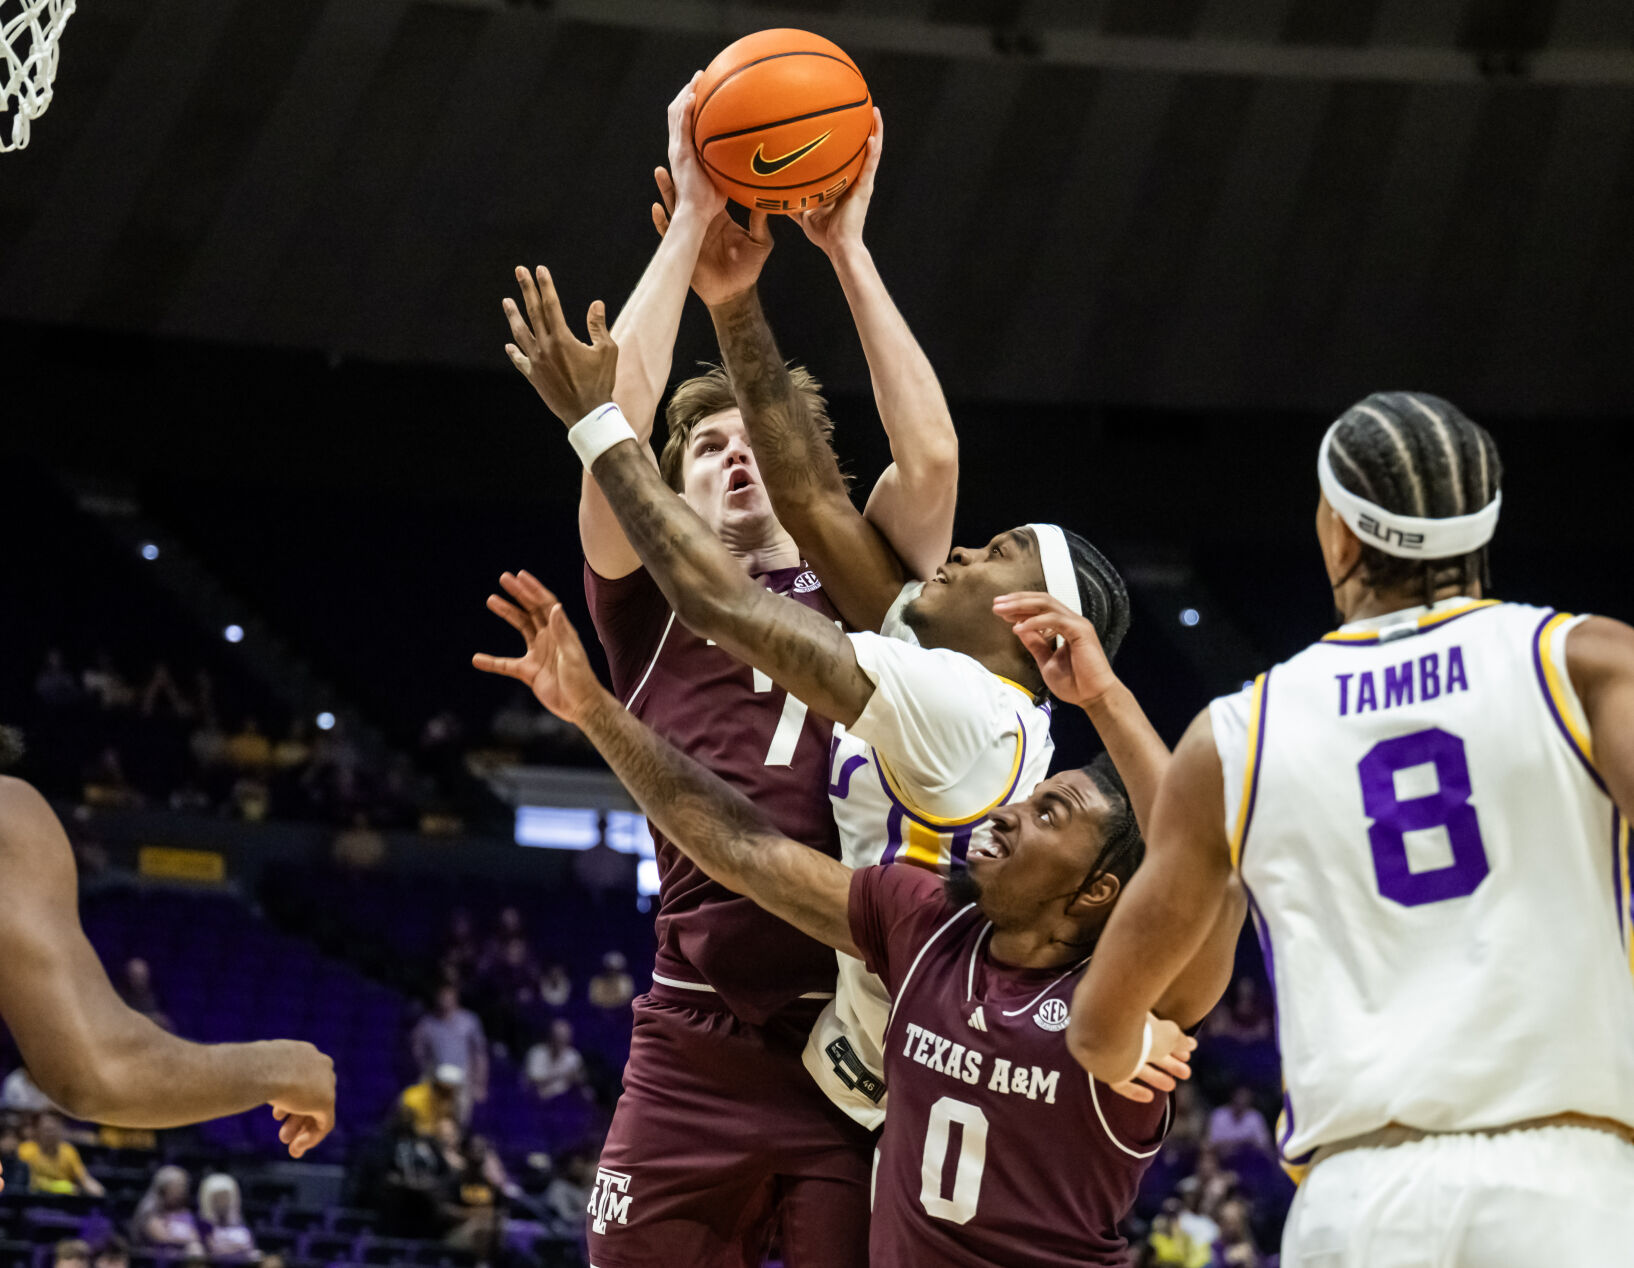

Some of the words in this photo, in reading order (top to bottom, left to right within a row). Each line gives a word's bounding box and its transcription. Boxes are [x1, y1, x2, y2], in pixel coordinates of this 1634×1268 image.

[755, 177, 847, 210] ELITE
[1334, 646, 1469, 716] TAMBA
[1357, 727, 1491, 907] 8
[1042, 1001, 1065, 1022] SEC
[902, 1022, 983, 1085] TEXAS
[988, 1057, 1060, 1104] A&M
[919, 1096, 989, 1225] 0
